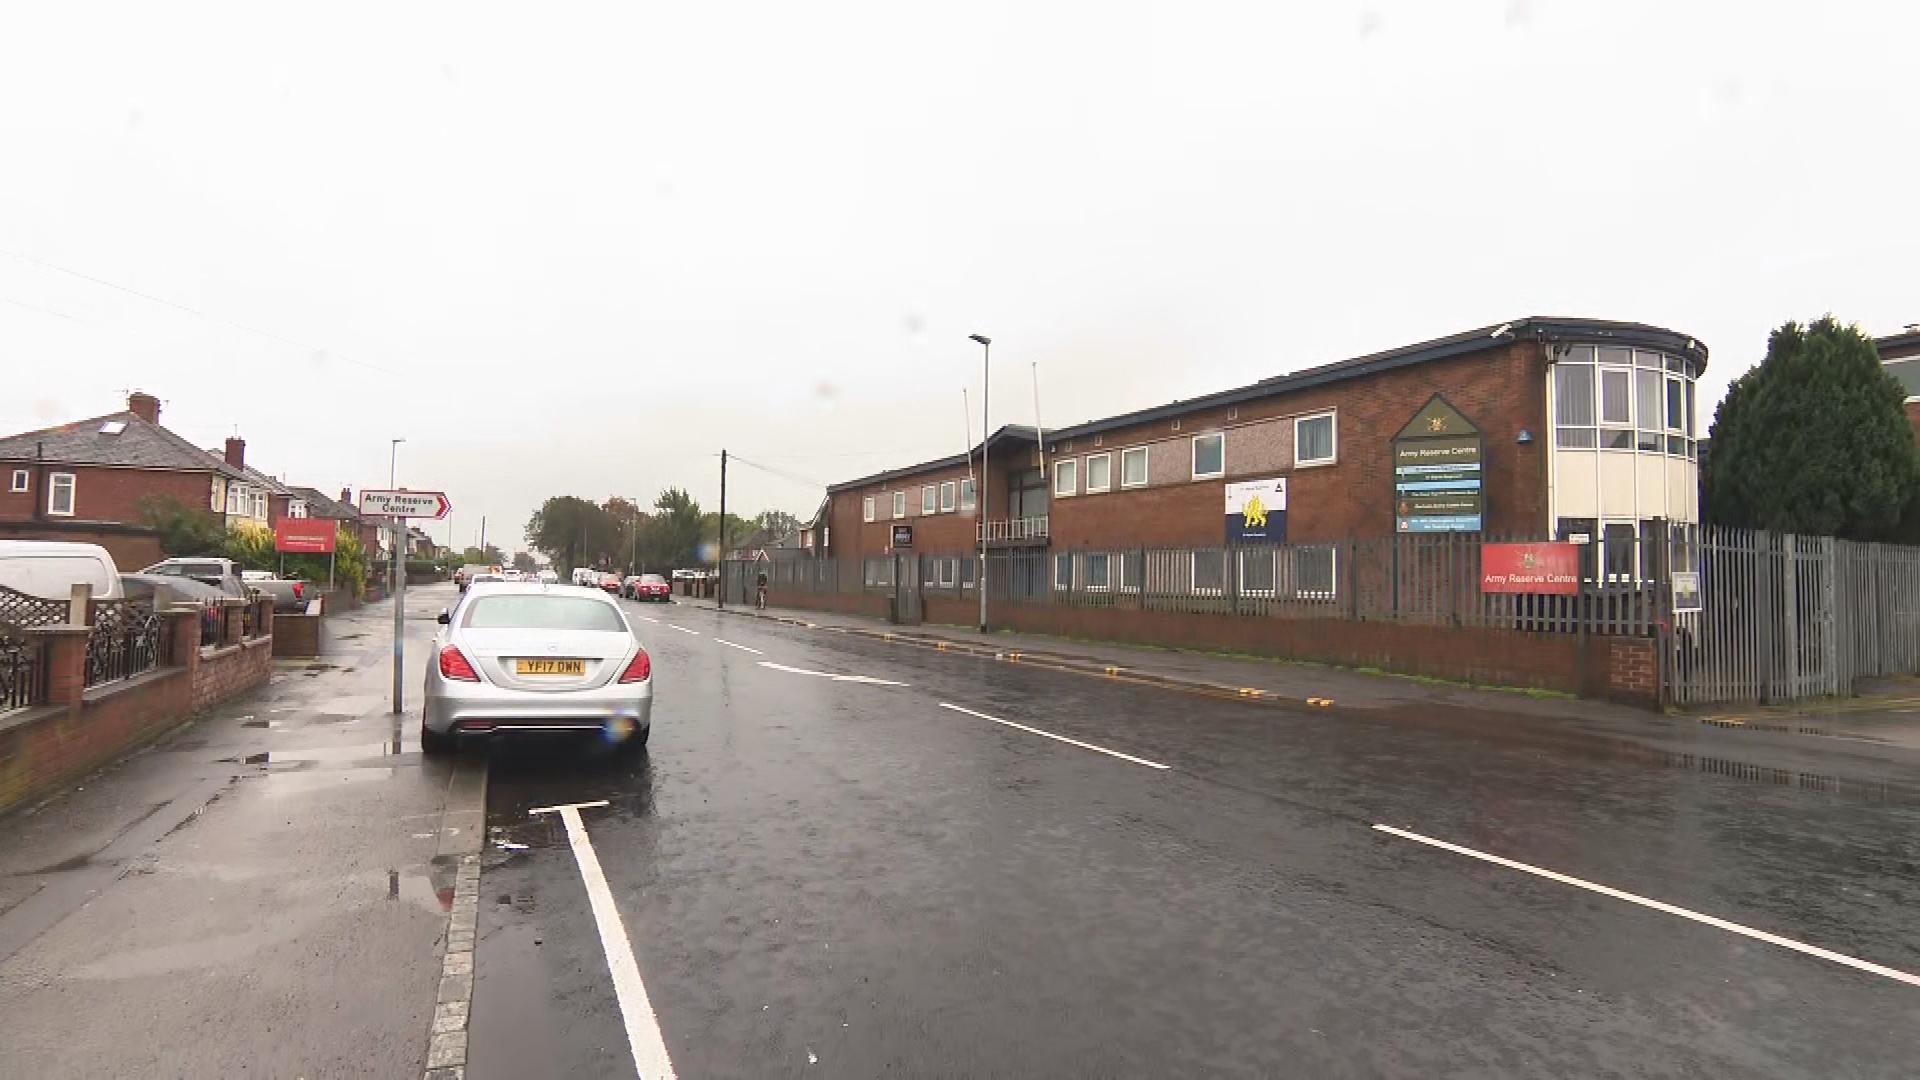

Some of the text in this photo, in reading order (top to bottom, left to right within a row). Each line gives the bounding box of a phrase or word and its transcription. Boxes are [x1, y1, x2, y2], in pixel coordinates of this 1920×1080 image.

[1400, 446, 1477, 458] Army Reserve Centre
[365, 493, 433, 505] Army Reserve
[382, 504, 416, 513] Centre
[1485, 573, 1577, 585] Army Reserve Centre
[527, 661, 581, 673] YF17 DWN
